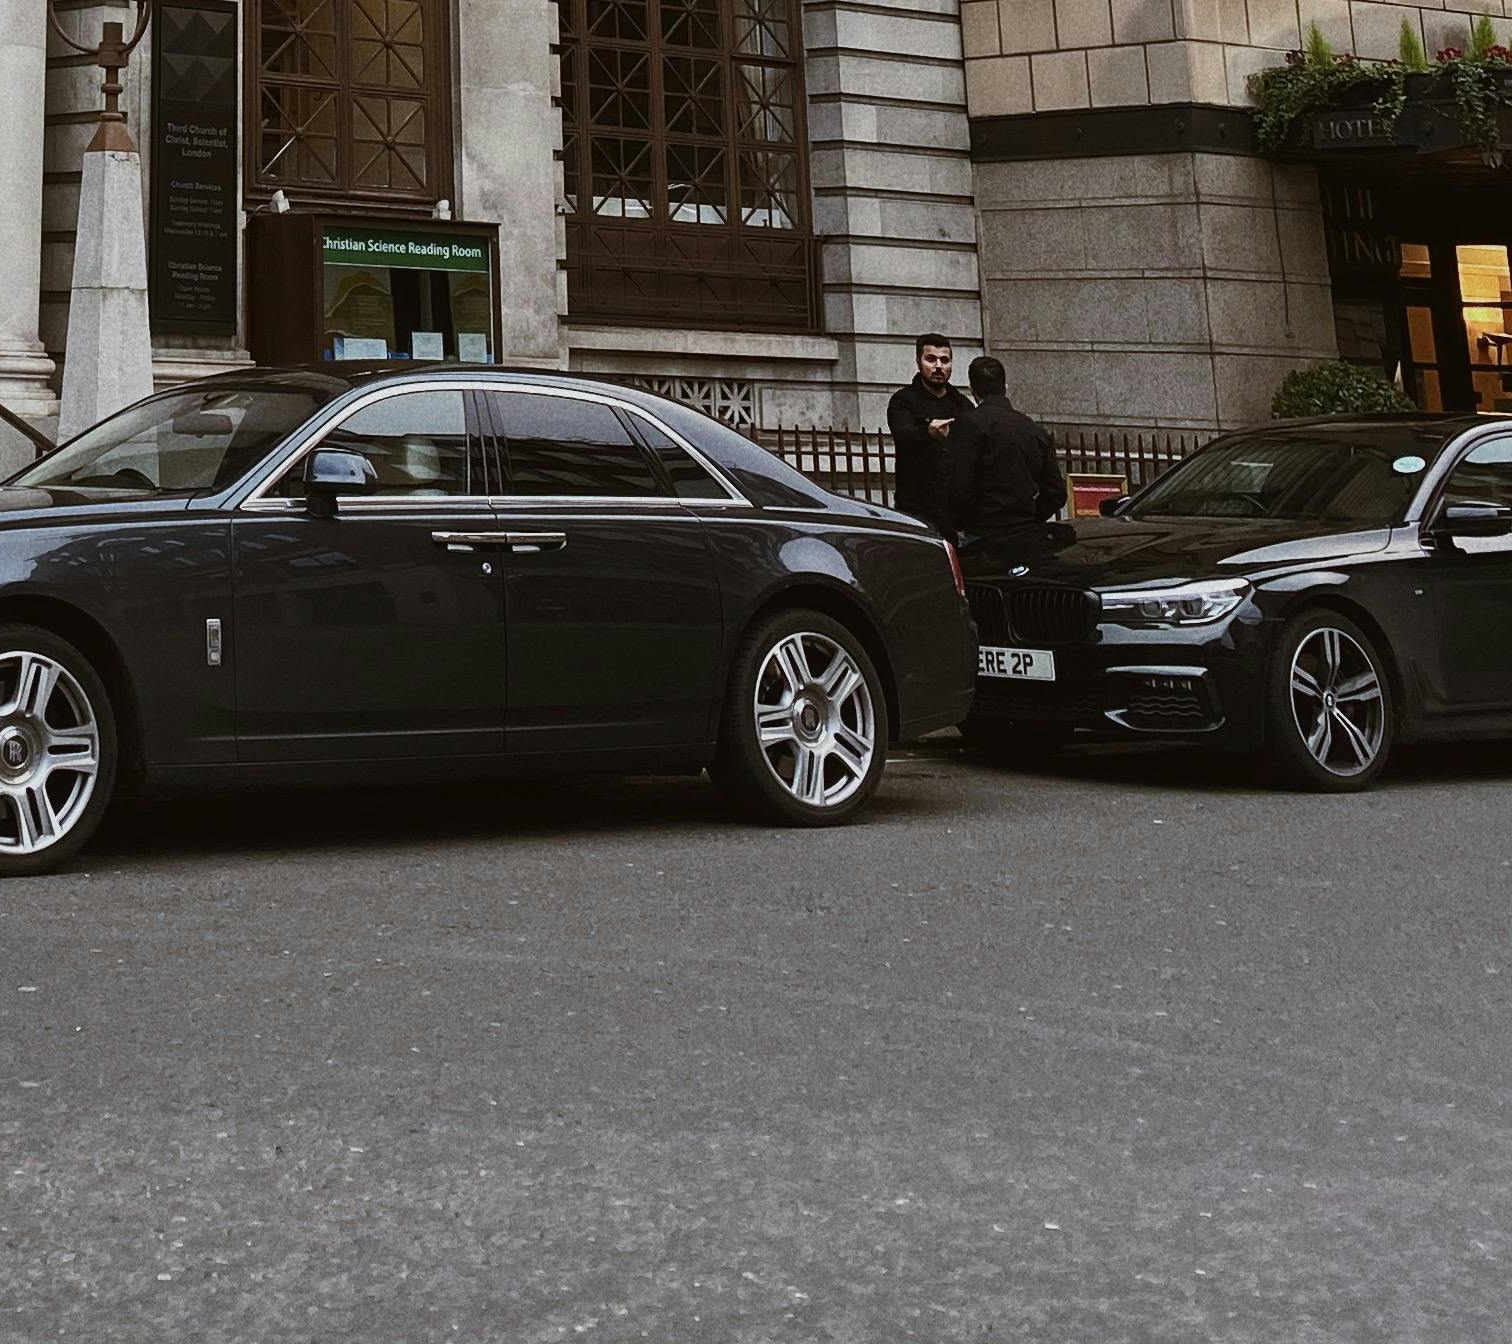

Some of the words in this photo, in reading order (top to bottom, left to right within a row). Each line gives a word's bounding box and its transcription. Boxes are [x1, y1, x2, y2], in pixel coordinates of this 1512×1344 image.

[367, 239, 407, 253] Science
[408, 242, 449, 259] Reading
[451, 244, 482, 258] Room
[1011, 652, 1034, 675] 2P
